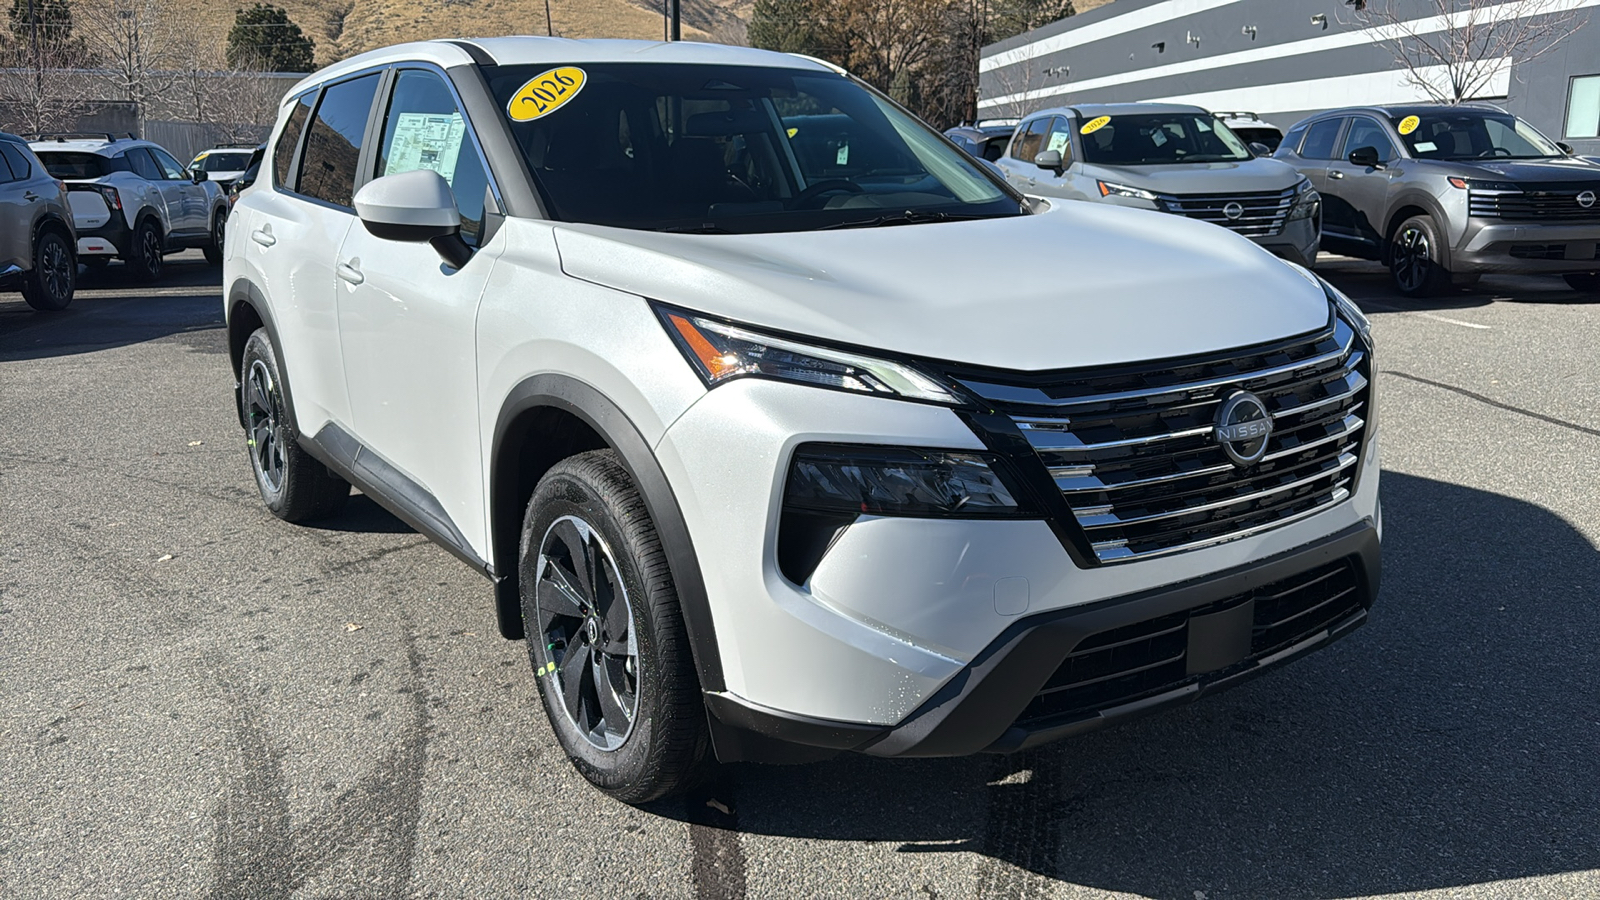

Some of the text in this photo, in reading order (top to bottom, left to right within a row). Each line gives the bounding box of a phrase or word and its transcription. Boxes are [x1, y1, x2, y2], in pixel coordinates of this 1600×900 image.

[521, 71, 575, 113] 2026
[1086, 118, 1106, 131] 2026
[1218, 421, 1273, 440] NISSAN
